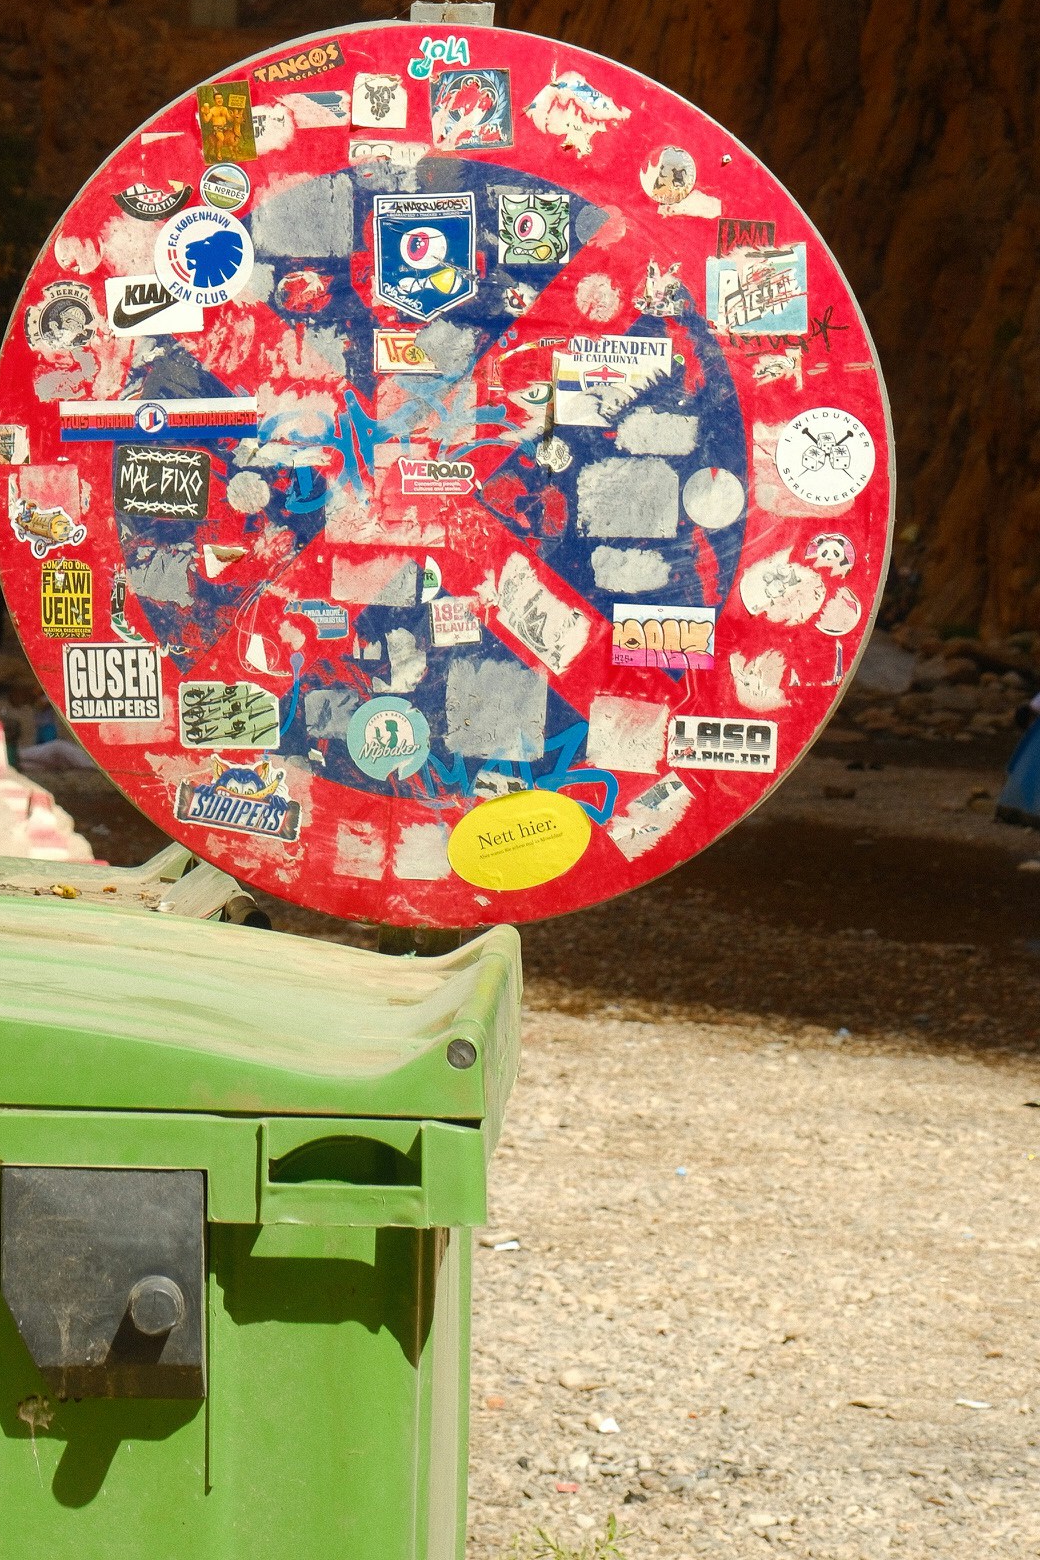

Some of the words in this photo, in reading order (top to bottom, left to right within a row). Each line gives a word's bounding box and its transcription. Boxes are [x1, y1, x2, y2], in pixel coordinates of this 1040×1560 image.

[254, 44, 339, 82] TANGOS
[203, 182, 212, 191] EL
[136, 197, 177, 212] CROATIA
[174, 211, 231, 234] KØBENHAVN
[168, 281, 193, 301] FAN
[195, 289, 229, 305] CLUB
[585, 354, 639, 365] CATALUNYA
[792, 411, 870, 448] WILDUNGER
[400, 460, 473, 480] WEROAD
[160, 466, 204, 504] BIXO
[782, 467, 867, 502] STRICKVEREIN
[42, 560, 73, 570] COMRO
[435, 621, 478, 633] SLAVIA
[68, 647, 158, 698] GUSER
[71, 699, 158, 718] SUAIPERS
[674, 720, 771, 751] LASO
[477, 829, 515, 851] Nett
[517, 819, 557, 839] hier.
